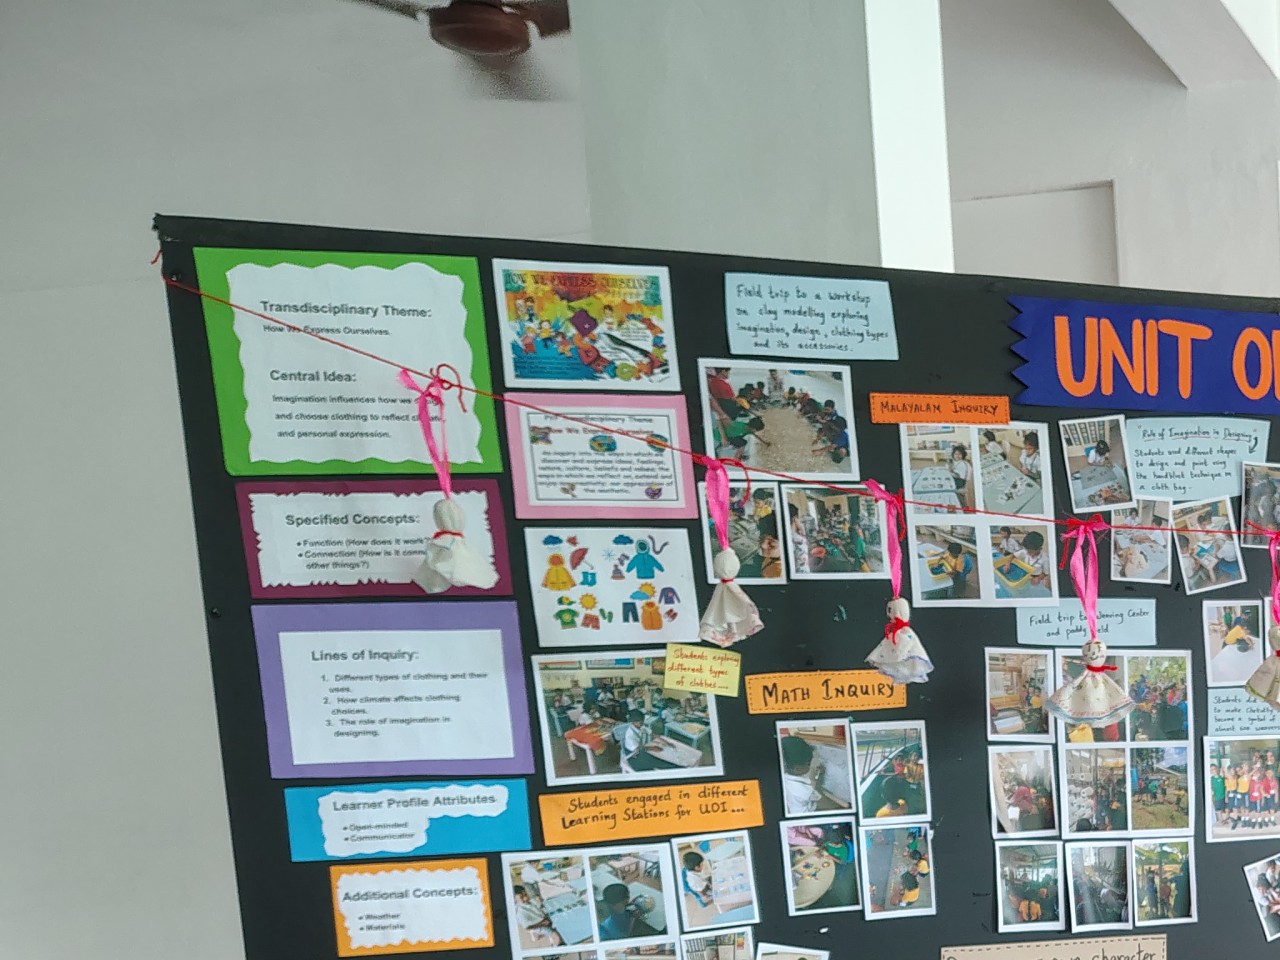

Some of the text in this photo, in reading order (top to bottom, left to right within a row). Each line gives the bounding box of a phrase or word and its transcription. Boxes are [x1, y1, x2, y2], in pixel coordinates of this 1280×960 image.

[736, 284, 762, 298] Field
[768, 283, 789, 302] trip
[796, 286, 806, 298] to
[260, 301, 432, 318] Transdisciplinary Theme:
[1054, 313, 1212, 398] UNIT
[270, 370, 357, 382] Central Idea:
[272, 395, 327, 404] Imagination
[329, 395, 375, 403] influences
[378, 395, 398, 403] how
[331, 413, 367, 422] clothing
[370, 413, 379, 421] to
[285, 514, 420, 527] Specified Concepts:
[311, 650, 419, 662] Lines of Inquiry:
[668, 663, 729, 678] different types
[763, 679, 895, 707] MATH INQUIRY
[333, 794, 496, 811] Learner Profile Attributes
[569, 785, 748, 813] Students engaged in different
[563, 812, 617, 829] Learning
[623, 806, 671, 822] Stations
[676, 805, 691, 820] for
[342, 887, 478, 901] Additional Concepts:
